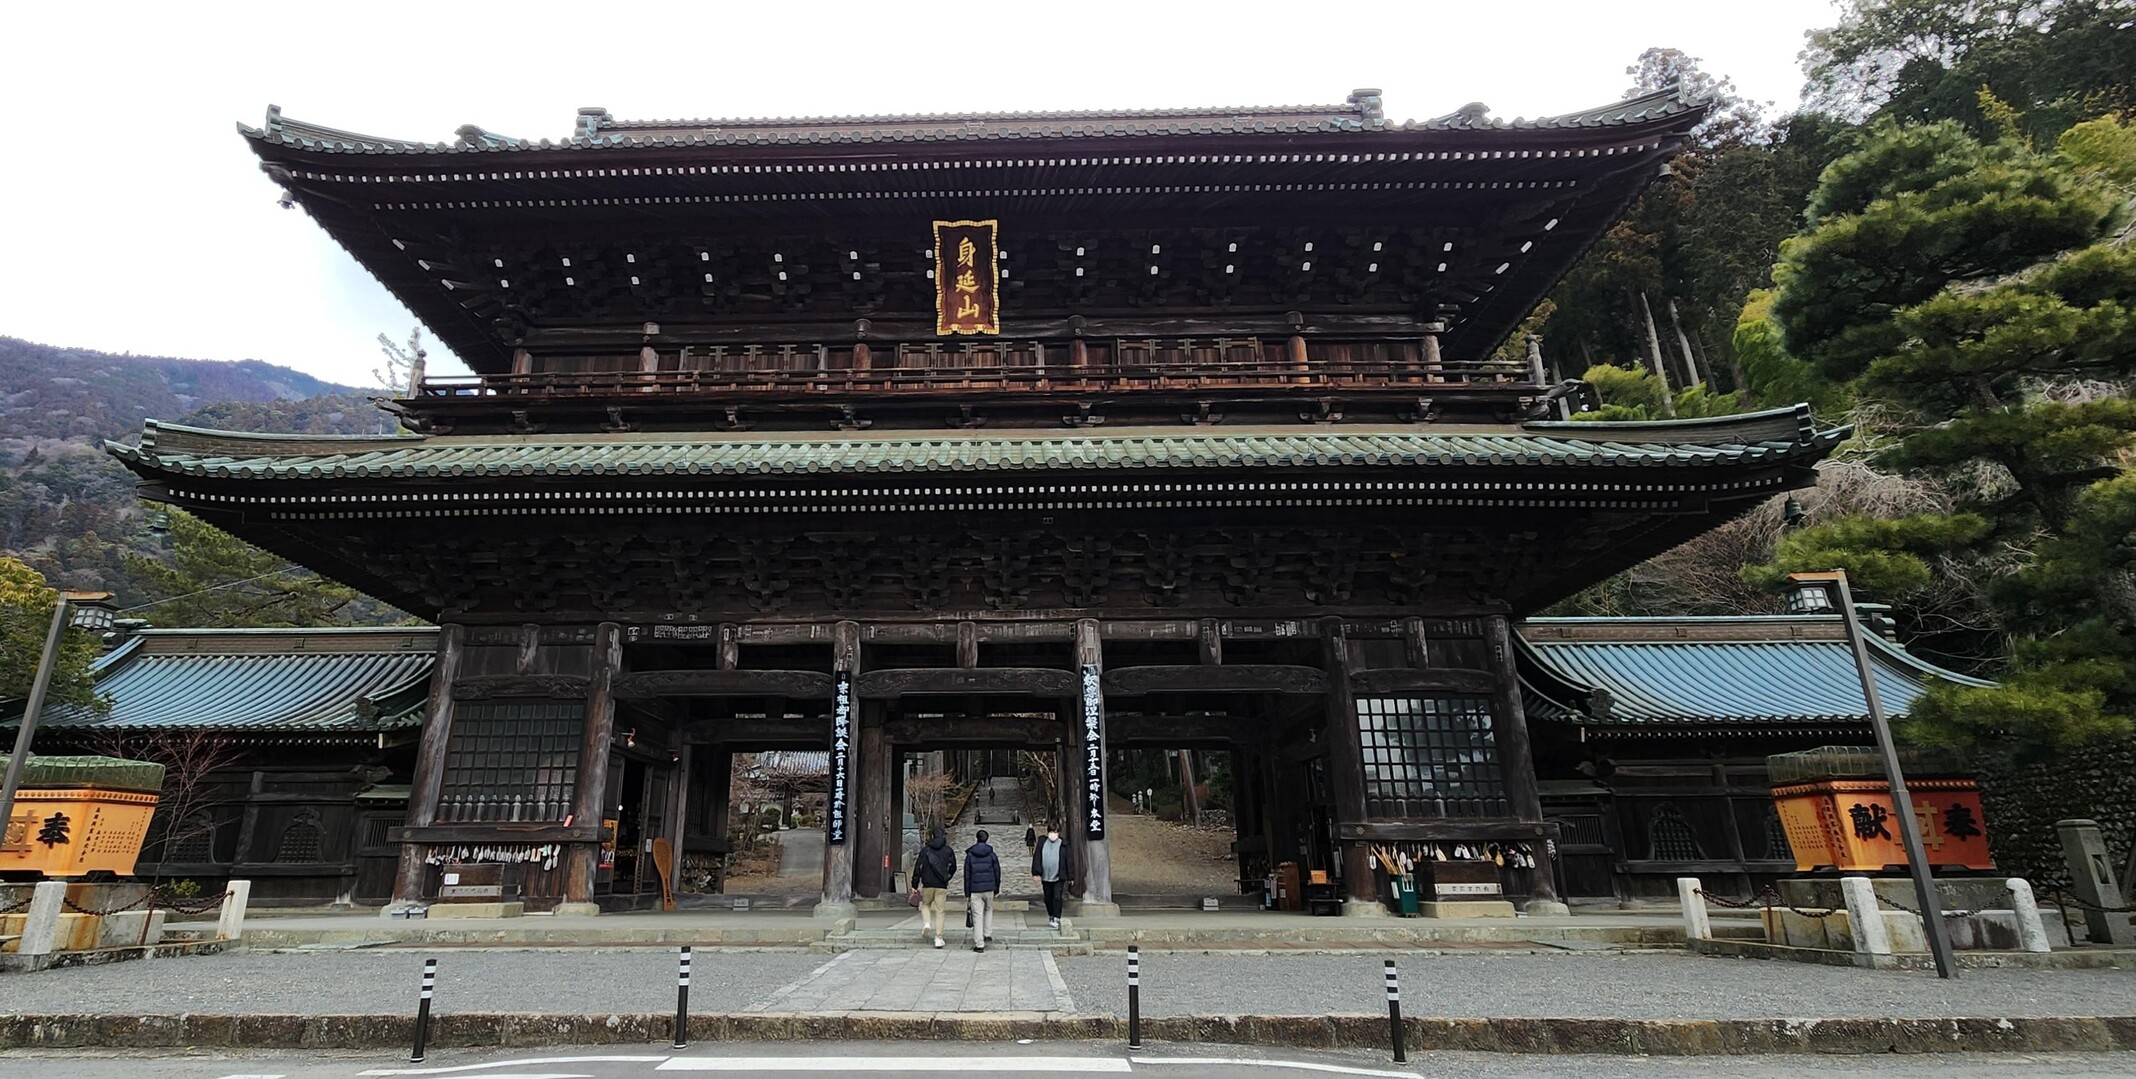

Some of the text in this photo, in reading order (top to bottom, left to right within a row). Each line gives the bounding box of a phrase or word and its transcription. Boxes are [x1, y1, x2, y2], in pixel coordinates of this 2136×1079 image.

[955, 236, 979, 319] 身延山
[36, 812, 71, 849] 奉
[1849, 803, 1891, 841] 献
[1944, 803, 1981, 841] 奉
